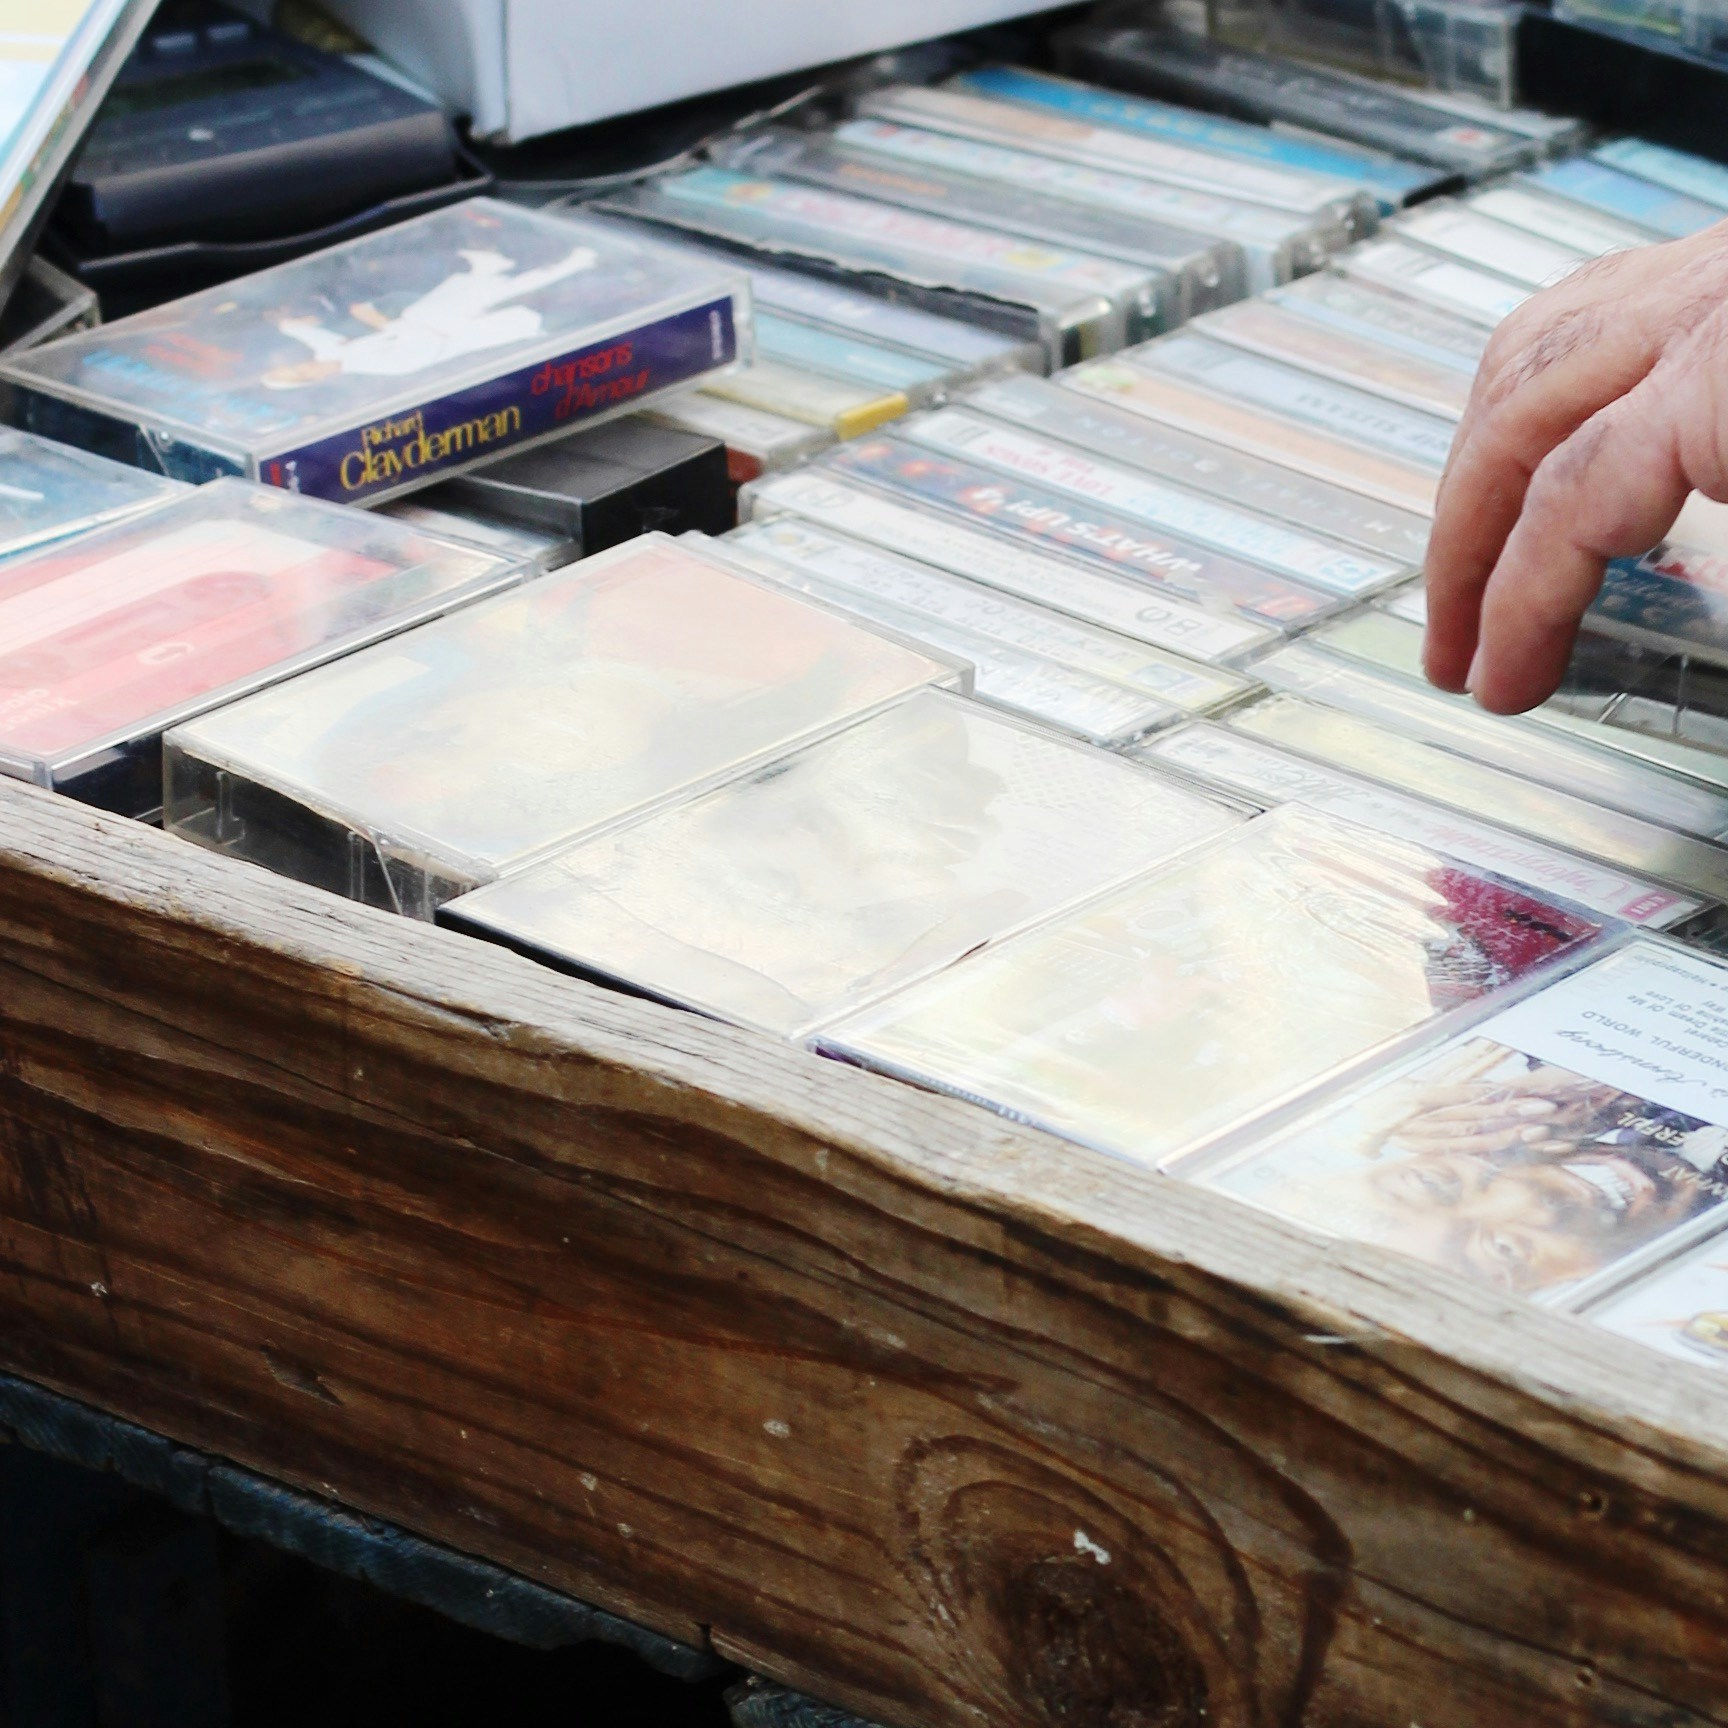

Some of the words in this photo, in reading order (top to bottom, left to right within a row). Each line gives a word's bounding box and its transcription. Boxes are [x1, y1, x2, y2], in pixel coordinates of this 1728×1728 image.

[362, 410, 422, 449] Richard
[341, 405, 520, 491] Clayderman
[1064, 519, 1203, 575] WHAT'S
[1623, 994, 1648, 1005] Me
[1642, 990, 1676, 1004] Love
[1645, 1003, 1666, 1012] Of
[1576, 1009, 1647, 1036] WORLD
[1540, 1027, 1718, 1090] Armstrong
